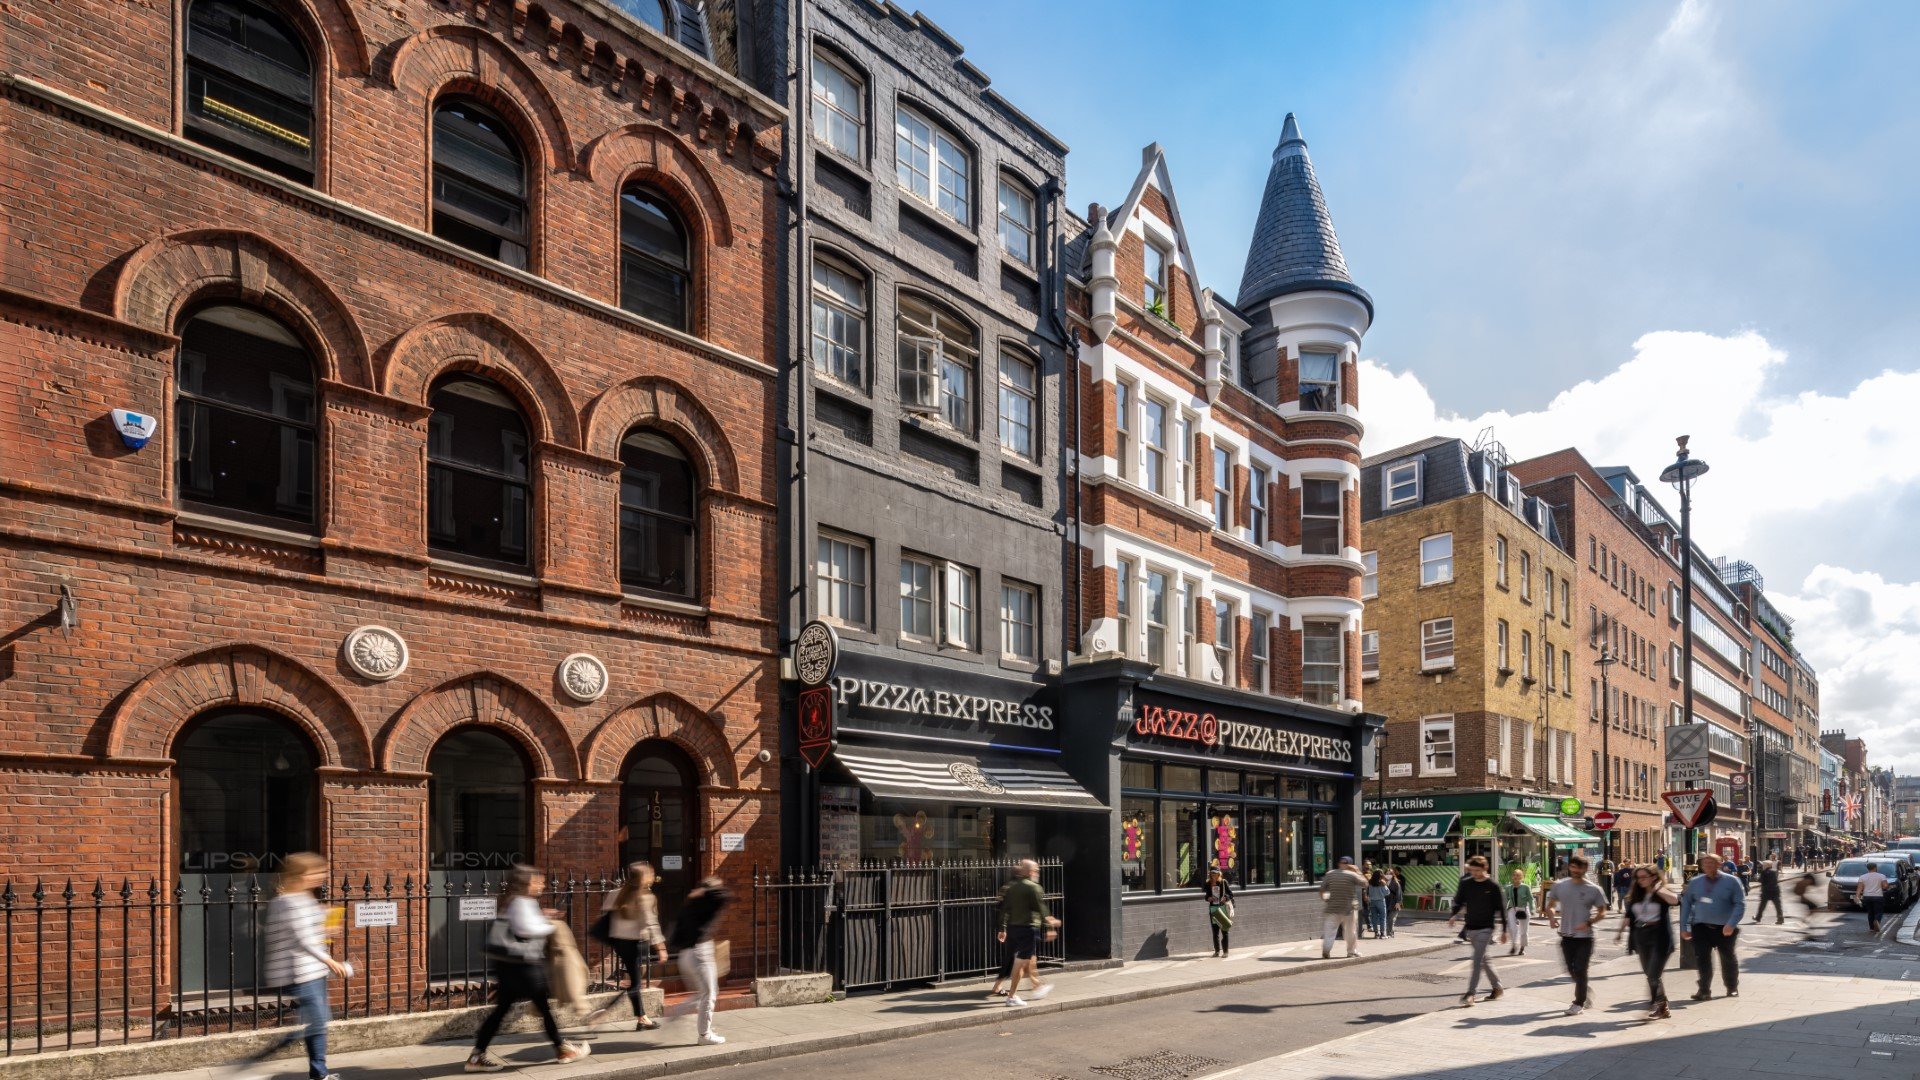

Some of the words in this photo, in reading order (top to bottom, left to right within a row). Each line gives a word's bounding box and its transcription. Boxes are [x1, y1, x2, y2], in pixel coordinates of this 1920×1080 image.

[1674, 761, 1700, 769] ZONE
[1671, 769, 1705, 779] ENDS
[1672, 795, 1700, 803] GIVE
[184, 851, 289, 869] LIPSYN
